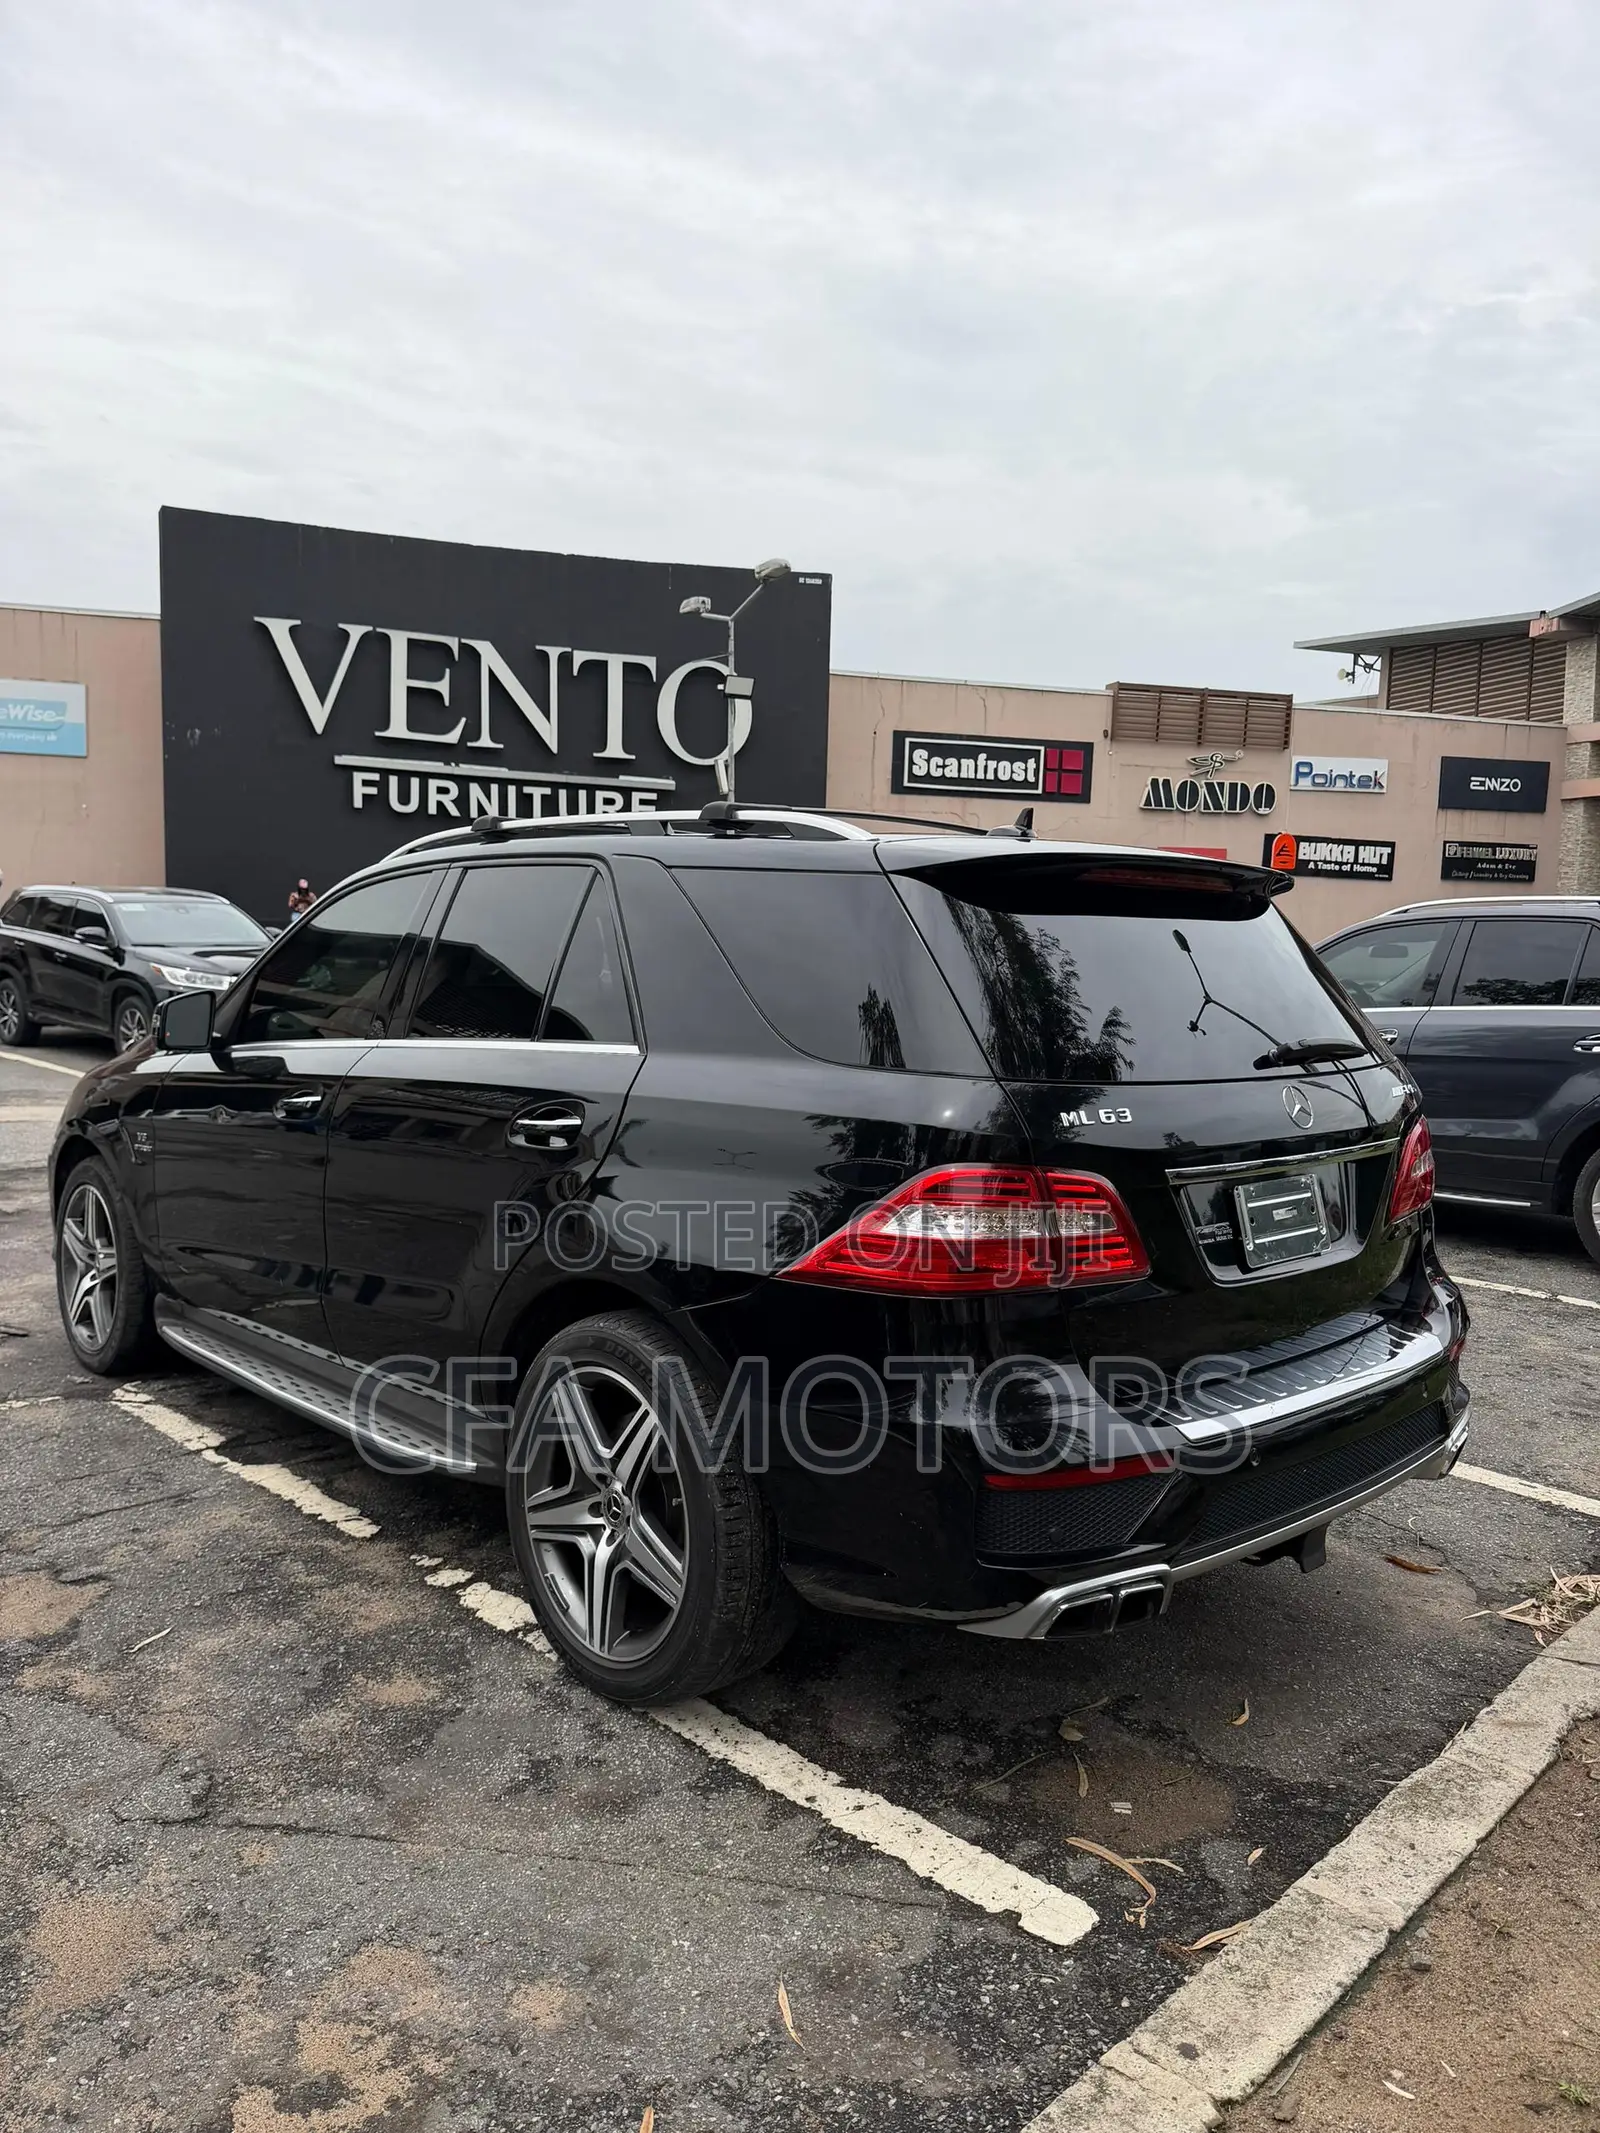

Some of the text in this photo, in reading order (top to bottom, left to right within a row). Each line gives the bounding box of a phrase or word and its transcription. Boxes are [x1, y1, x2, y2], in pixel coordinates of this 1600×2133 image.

[254, 615, 753, 766] VENTO
[911, 748, 1037, 783] Scanfrost
[1294, 761, 1385, 789] Pointek
[352, 771, 659, 819] FURNITURE
[1139, 776, 1276, 815] MONDO
[1298, 841, 1392, 865] BUKKA HUT
[1308, 861, 1378, 873] A Taste of Home
[1060, 1107, 1133, 1127] ML 63
